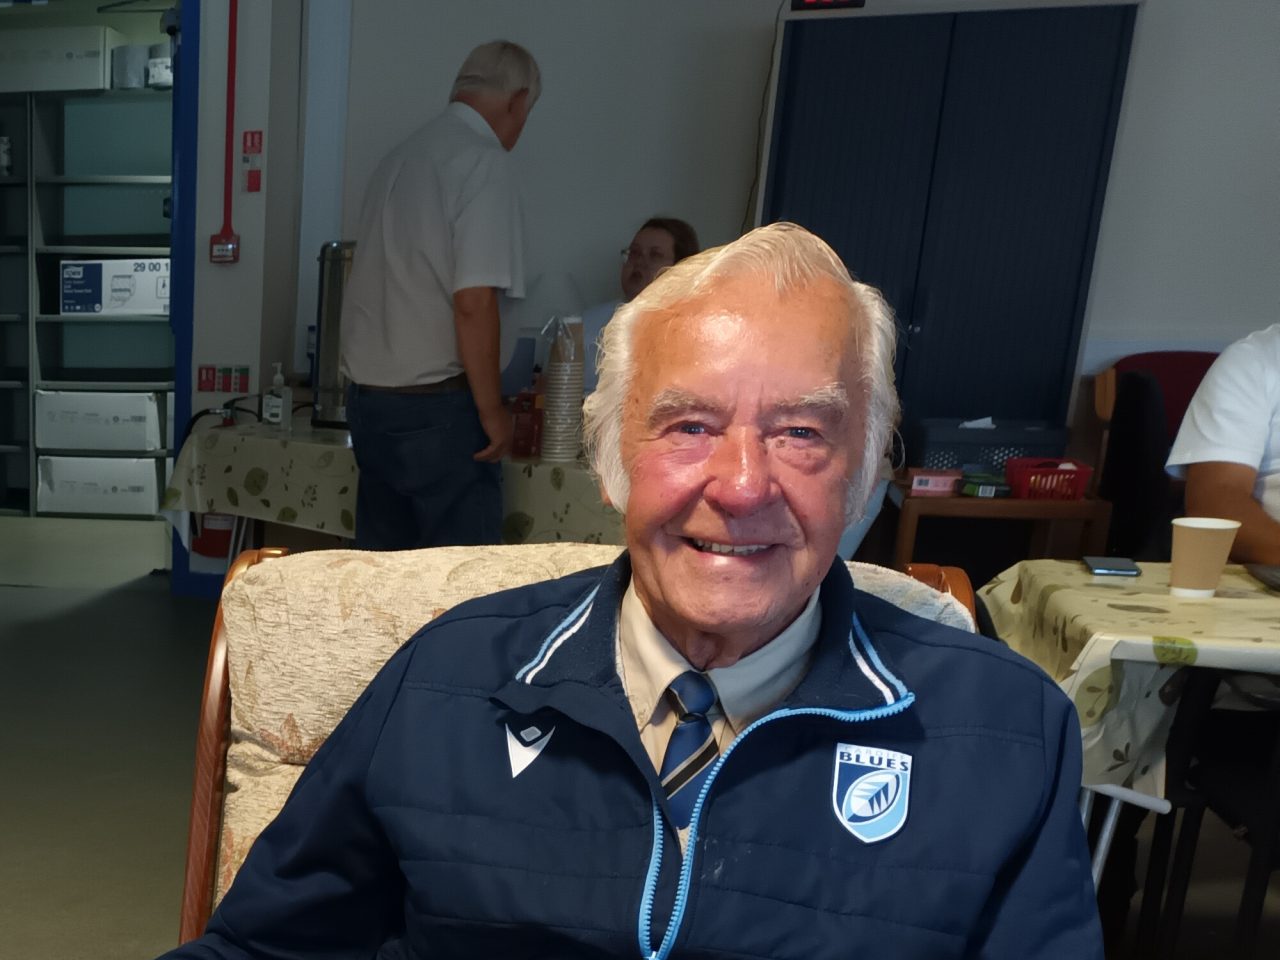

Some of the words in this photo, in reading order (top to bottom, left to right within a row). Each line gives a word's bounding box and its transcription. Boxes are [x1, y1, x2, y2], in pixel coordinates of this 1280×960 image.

[133, 262, 146, 272] 29
[148, 262, 161, 272] 00
[839, 751, 909, 772] BLUES
